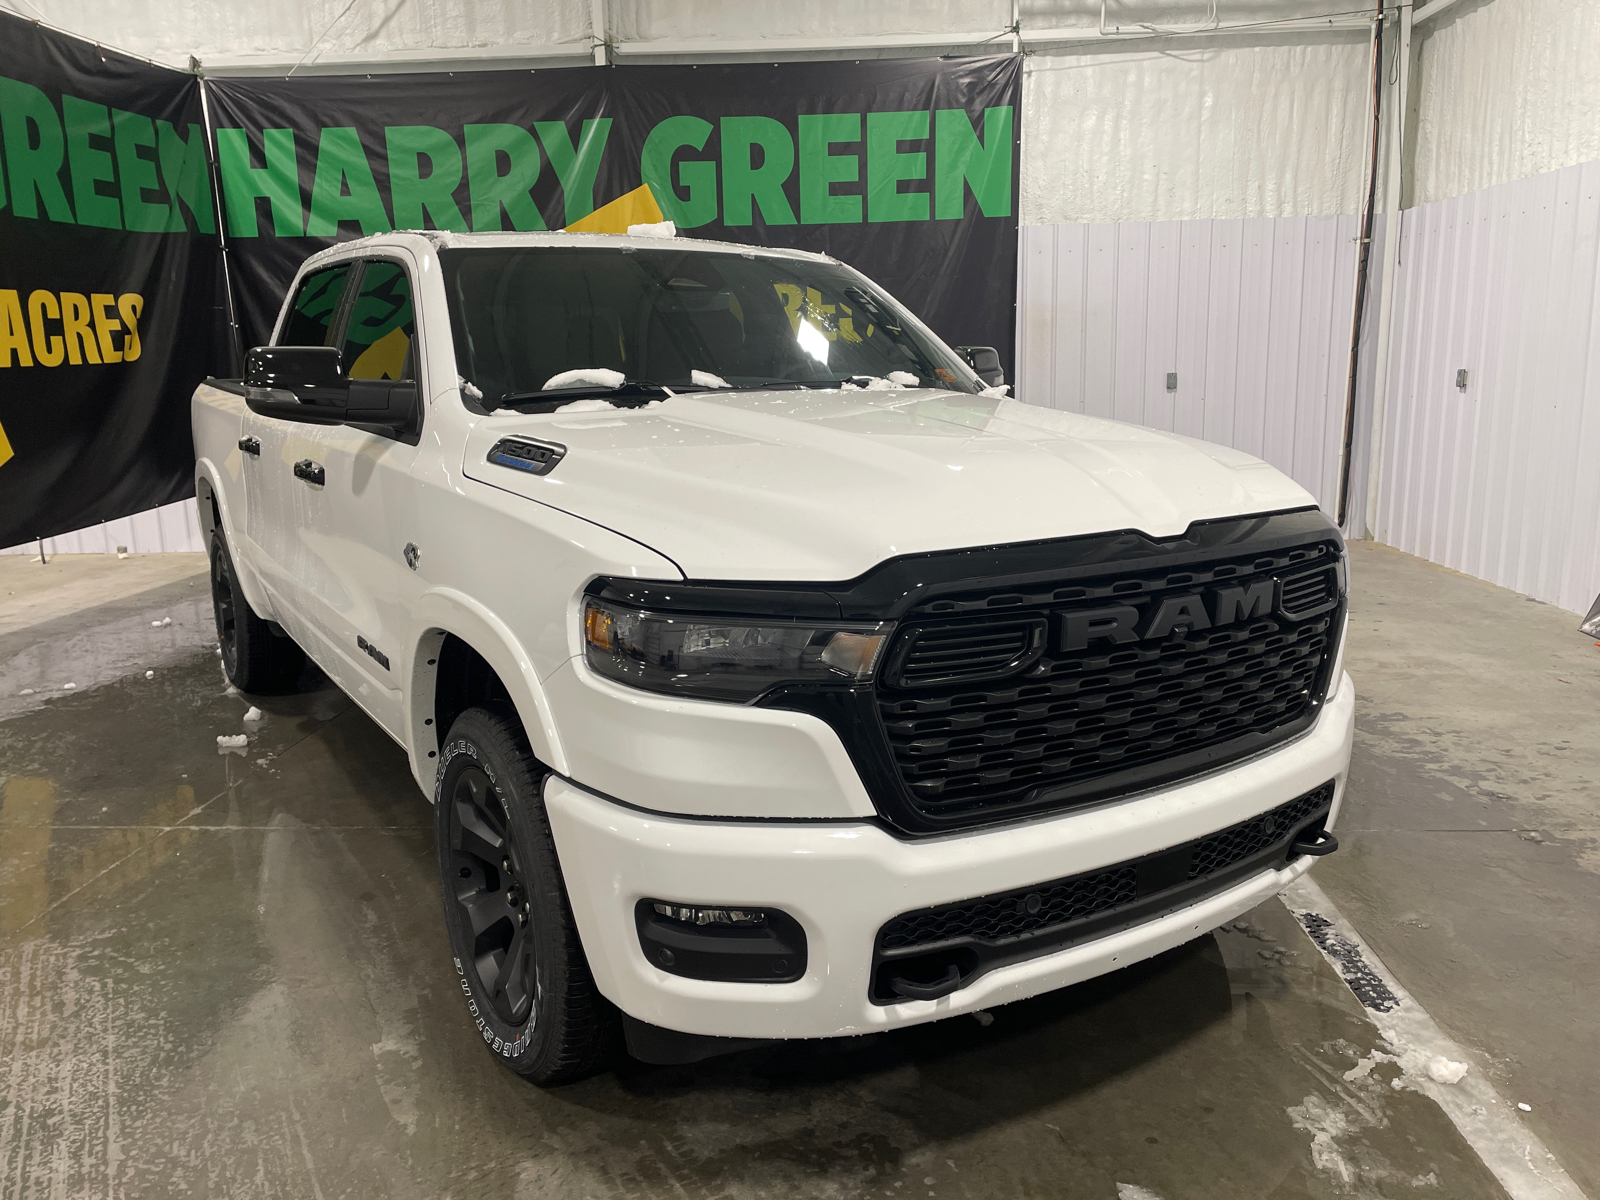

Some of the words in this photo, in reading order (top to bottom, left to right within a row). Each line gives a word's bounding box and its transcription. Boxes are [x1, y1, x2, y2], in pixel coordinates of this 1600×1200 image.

[0, 76, 215, 234] REEN
[216, 117, 613, 238] HARRY
[640, 105, 1014, 229] GREEN
[0, 289, 144, 368] ACRES
[498, 441, 553, 462] 1500
[356, 634, 391, 672] RAM
[1055, 579, 1275, 652] RAM
[454, 956, 537, 1058] BRIDGESTONE
